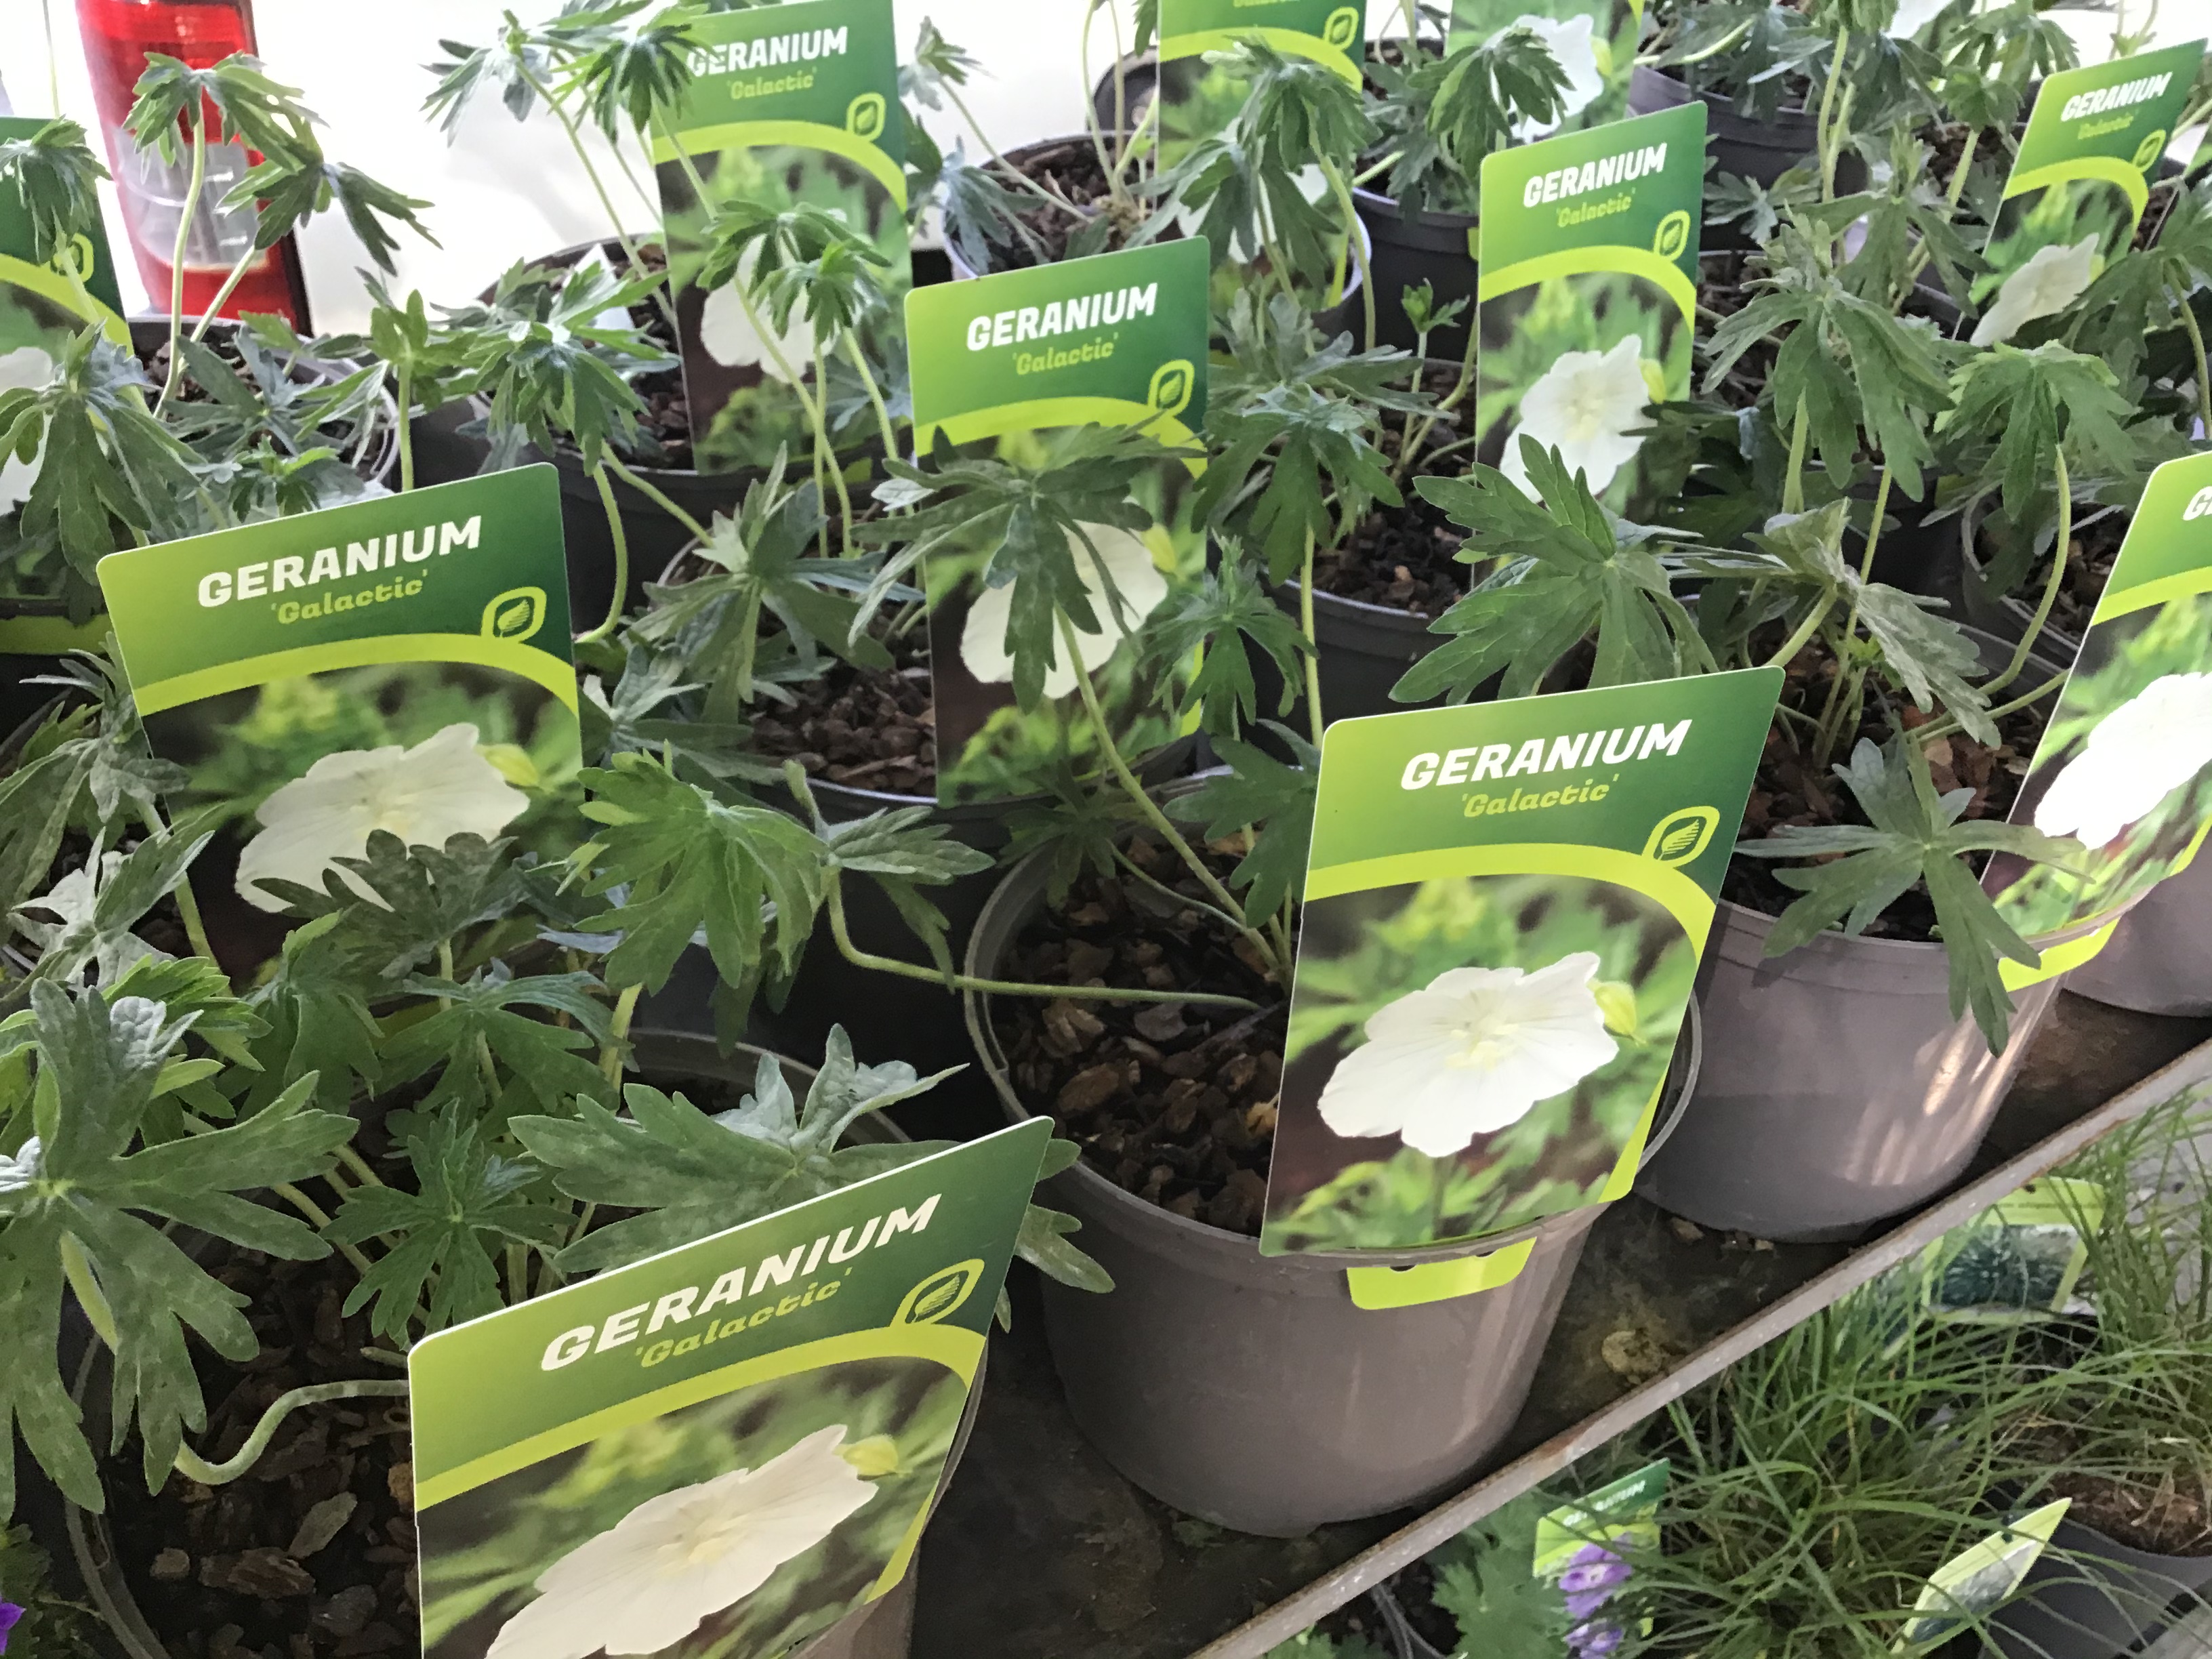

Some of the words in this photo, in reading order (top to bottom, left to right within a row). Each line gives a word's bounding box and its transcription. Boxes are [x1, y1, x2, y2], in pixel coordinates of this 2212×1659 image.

[686, 26, 848, 77] GERANIUM
[2060, 71, 2173, 122] GERANIUM
[1523, 142, 1667, 208] GERANIUM
[967, 283, 1158, 351] GERANIUM
[1012, 332, 1119, 375] 'Galactic'
[198, 516, 481, 607] GERANIUM
[271, 569, 428, 624] 'Galactic'
[1401, 719, 1692, 790] GERANIUM
[1461, 773, 1620, 817] 'Galactic'
[541, 1193, 942, 1371] GERANIUM
[636, 1267, 853, 1368] 'Galactic'
